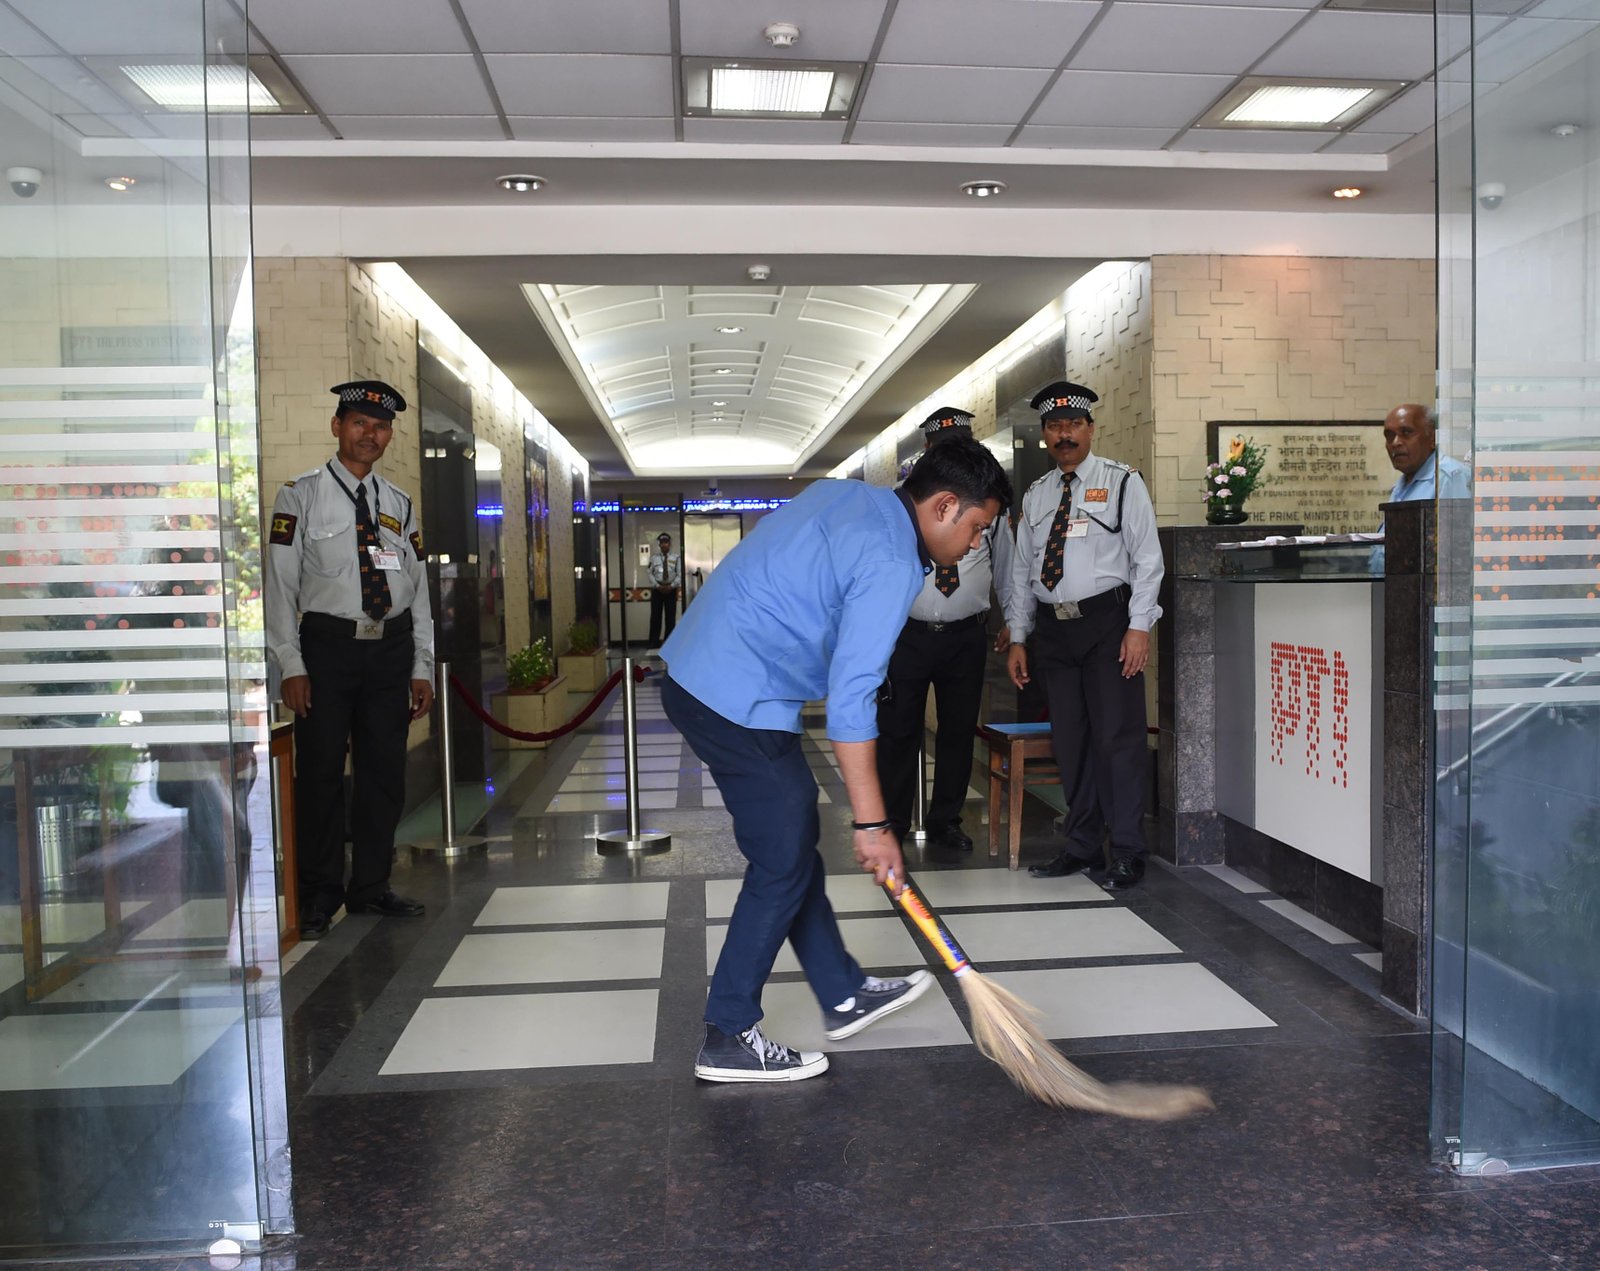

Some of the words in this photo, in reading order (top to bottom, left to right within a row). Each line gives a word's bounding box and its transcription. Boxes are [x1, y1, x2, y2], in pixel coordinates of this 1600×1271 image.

[115, 336, 142, 348] PRESS
[1278, 447, 1304, 457] भारत
[1306, 443, 1320, 457] की
[1278, 457, 1308, 472] श्रीमती
[1263, 490, 1307, 498] FOUNDATION
[1335, 489, 1345, 497] OF
[1348, 489, 1364, 497] THIS
[1248, 511, 1266, 522] THE
[1269, 511, 1300, 522] PRIME
[1303, 510, 1349, 521] MINISTER
[1353, 510, 1367, 521] OF
[1371, 510, 1383, 520] IN
[1340, 524, 1377, 534] GANDHI
